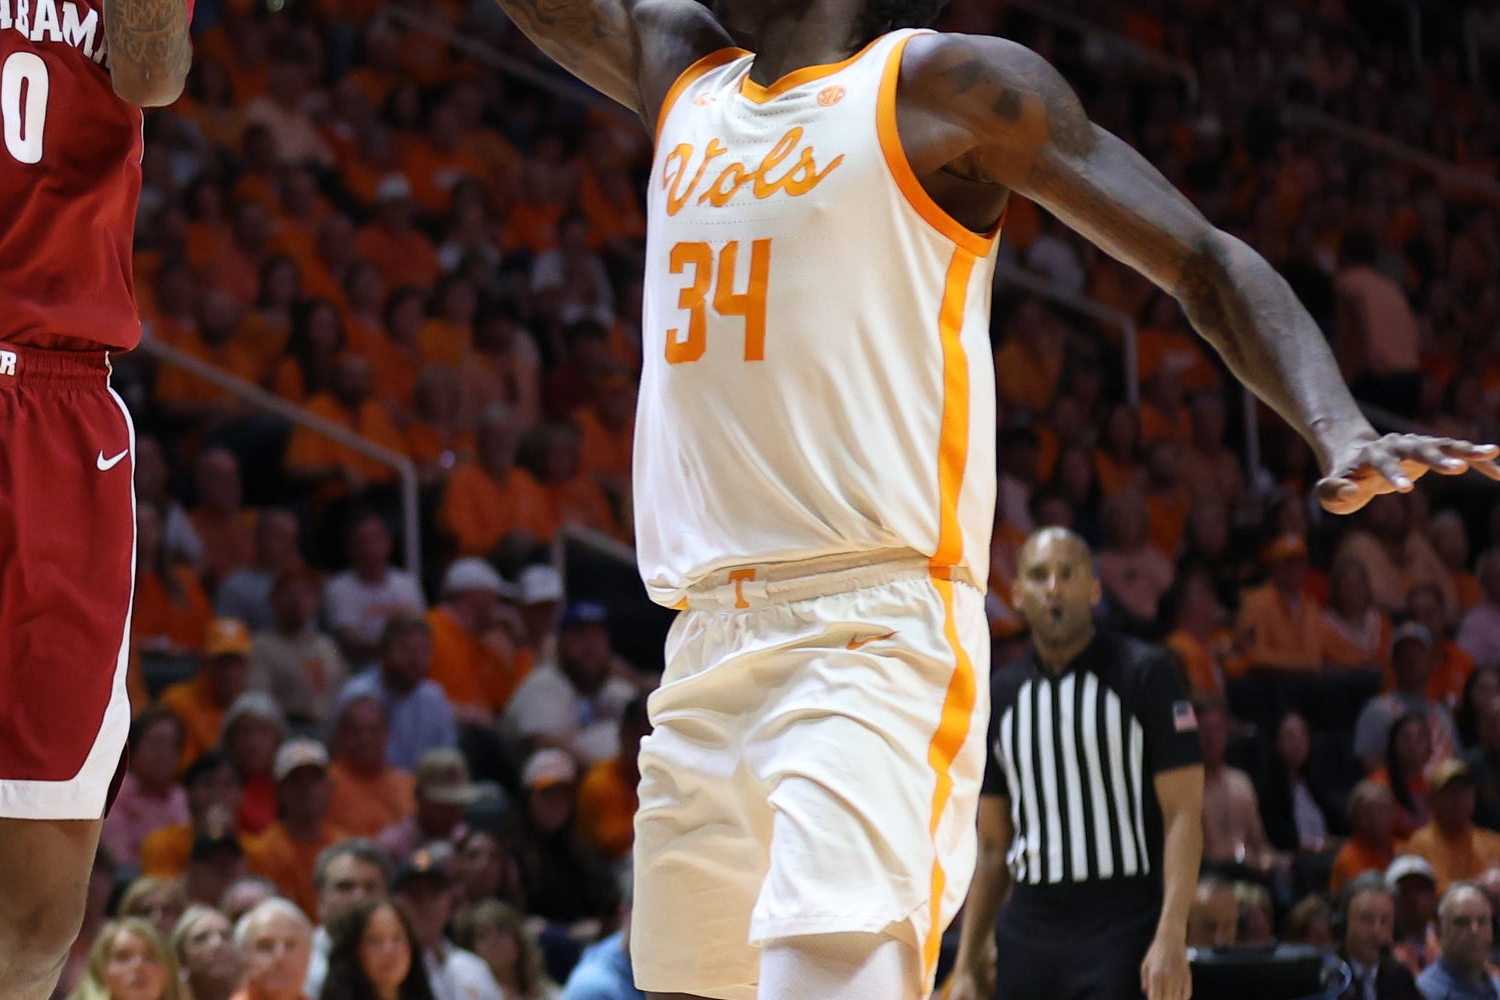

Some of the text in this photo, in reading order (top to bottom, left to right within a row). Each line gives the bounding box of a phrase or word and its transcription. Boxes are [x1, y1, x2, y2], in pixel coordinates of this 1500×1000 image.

[1, 51, 49, 164] 0
[662, 126, 845, 217] Vols
[664, 238, 772, 365] 34
